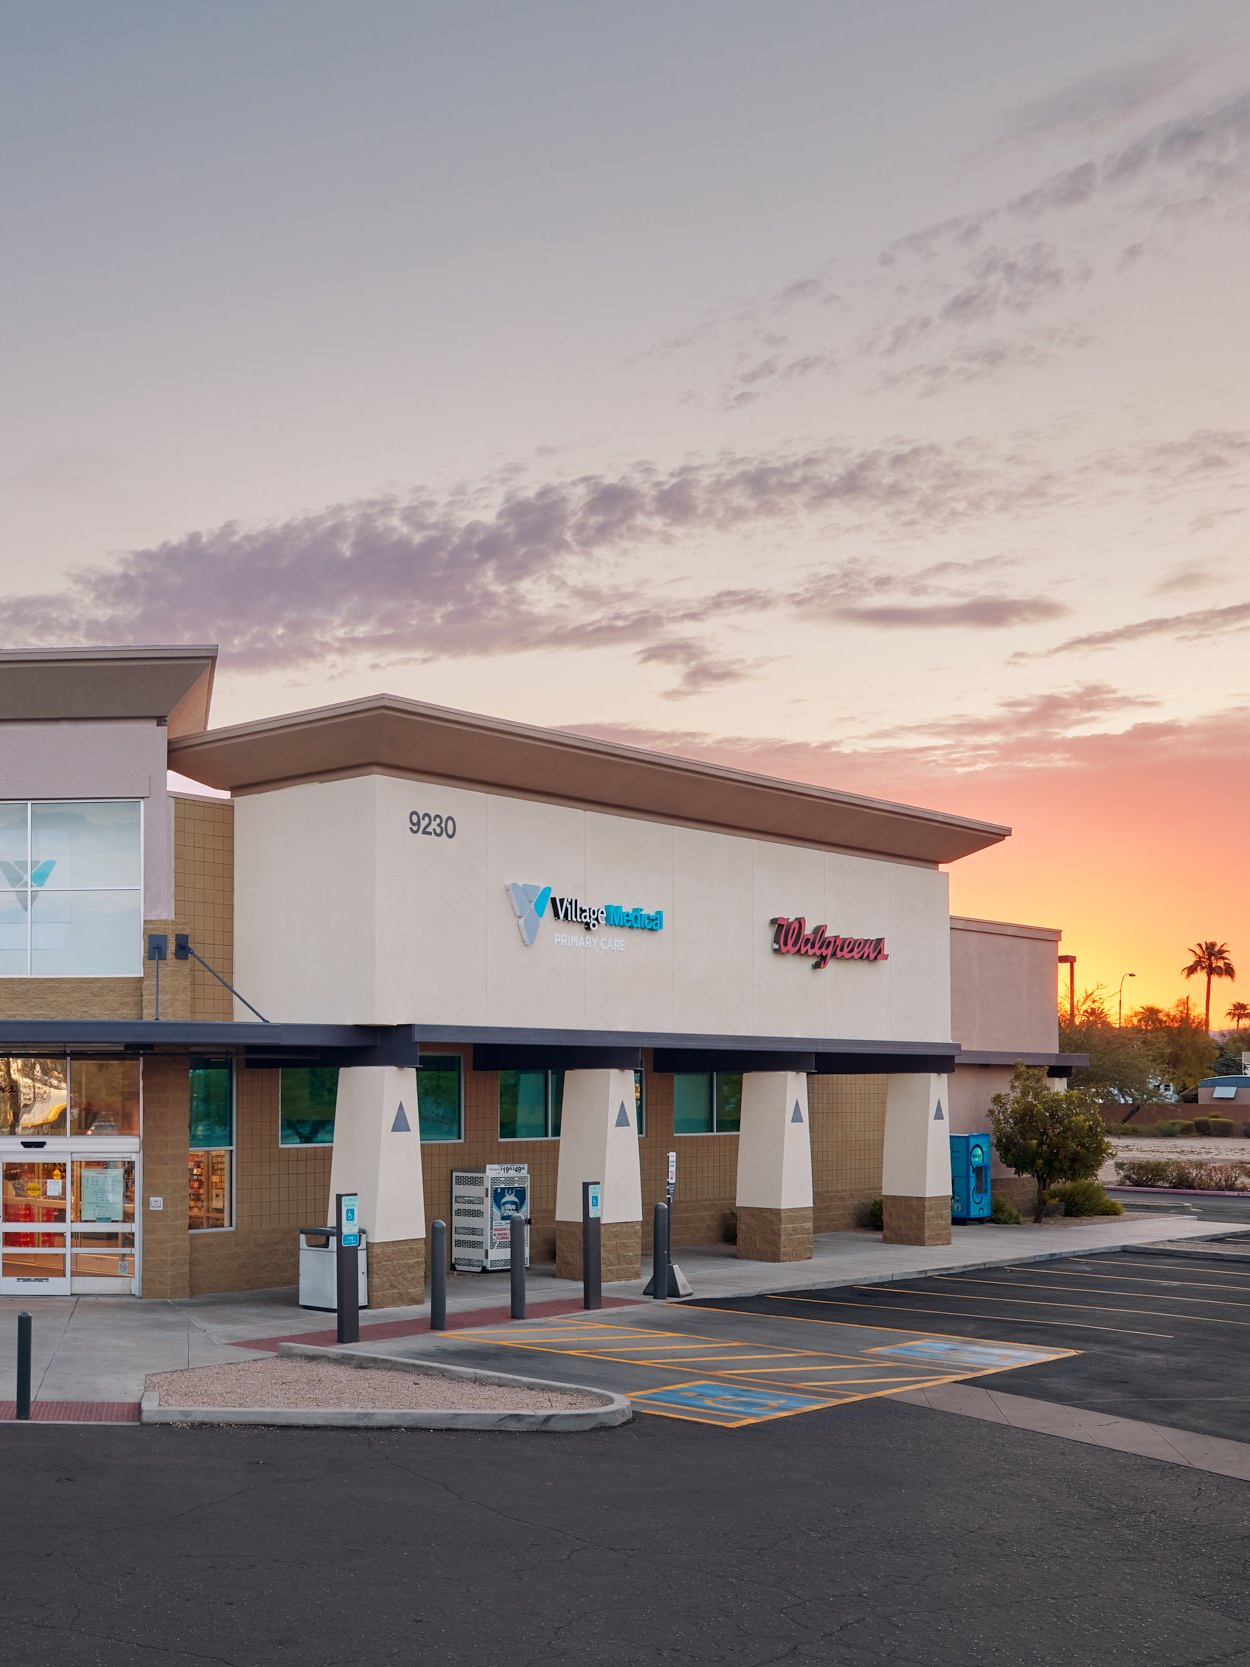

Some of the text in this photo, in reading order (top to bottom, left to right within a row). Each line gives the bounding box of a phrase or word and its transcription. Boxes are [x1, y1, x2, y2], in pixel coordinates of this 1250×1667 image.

[408, 810, 457, 839] 9230
[554, 933, 626, 952] PRIMARY CARE
[769, 916, 890, 970] Walgreens
